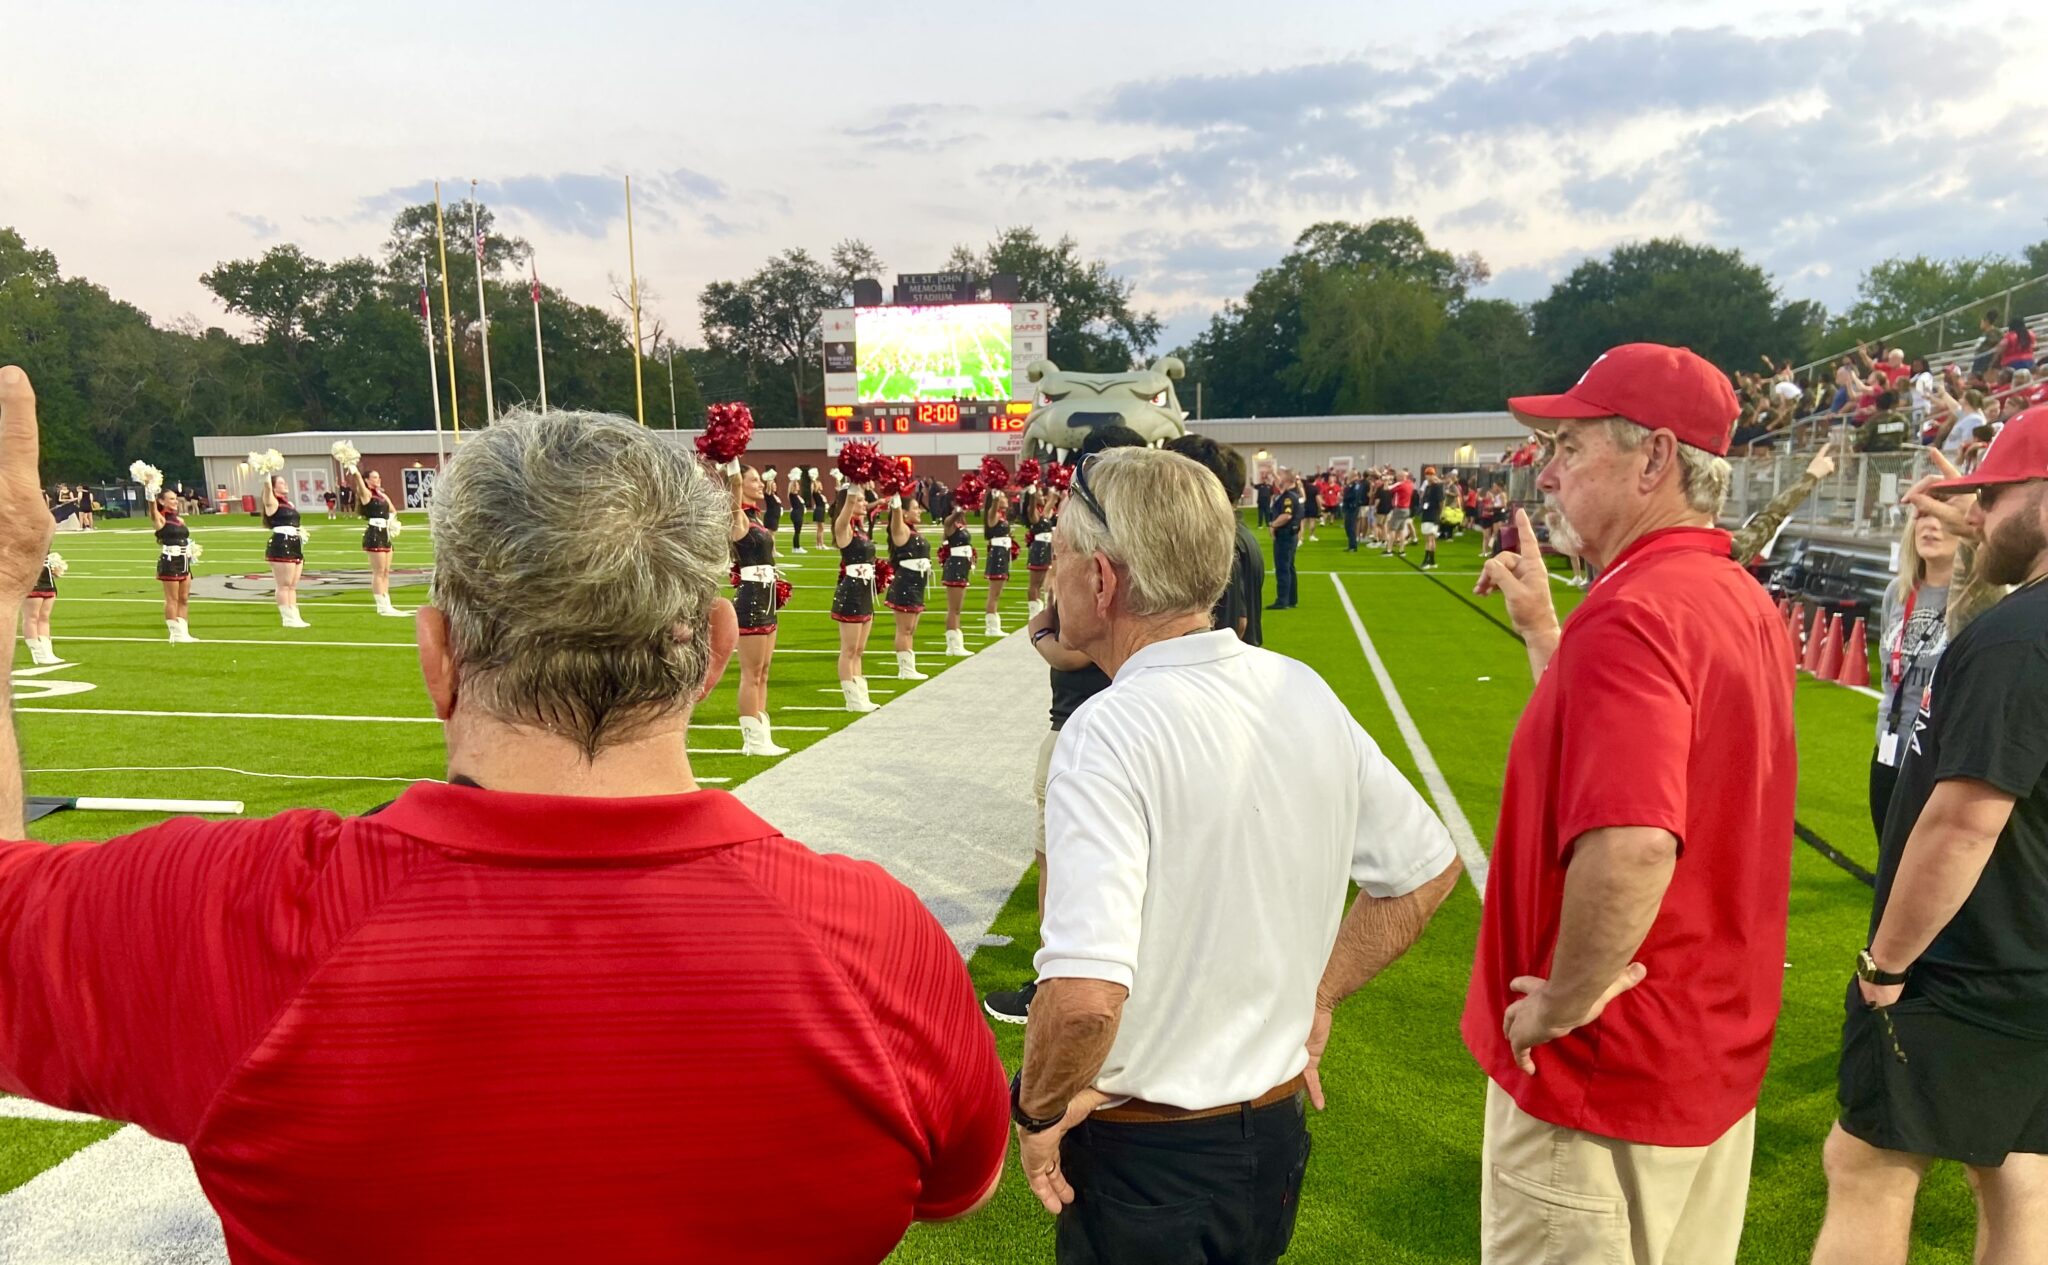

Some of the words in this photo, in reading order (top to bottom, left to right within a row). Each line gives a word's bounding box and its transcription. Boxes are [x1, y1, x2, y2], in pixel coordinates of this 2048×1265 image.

[937, 275, 962, 285] JOHN
[909, 284, 957, 292] MEMORIAL
[913, 293, 953, 302] STADIUM
[917, 404, 958, 423] 12:00
[837, 418, 848, 433] 0
[896, 417, 910, 432] 10
